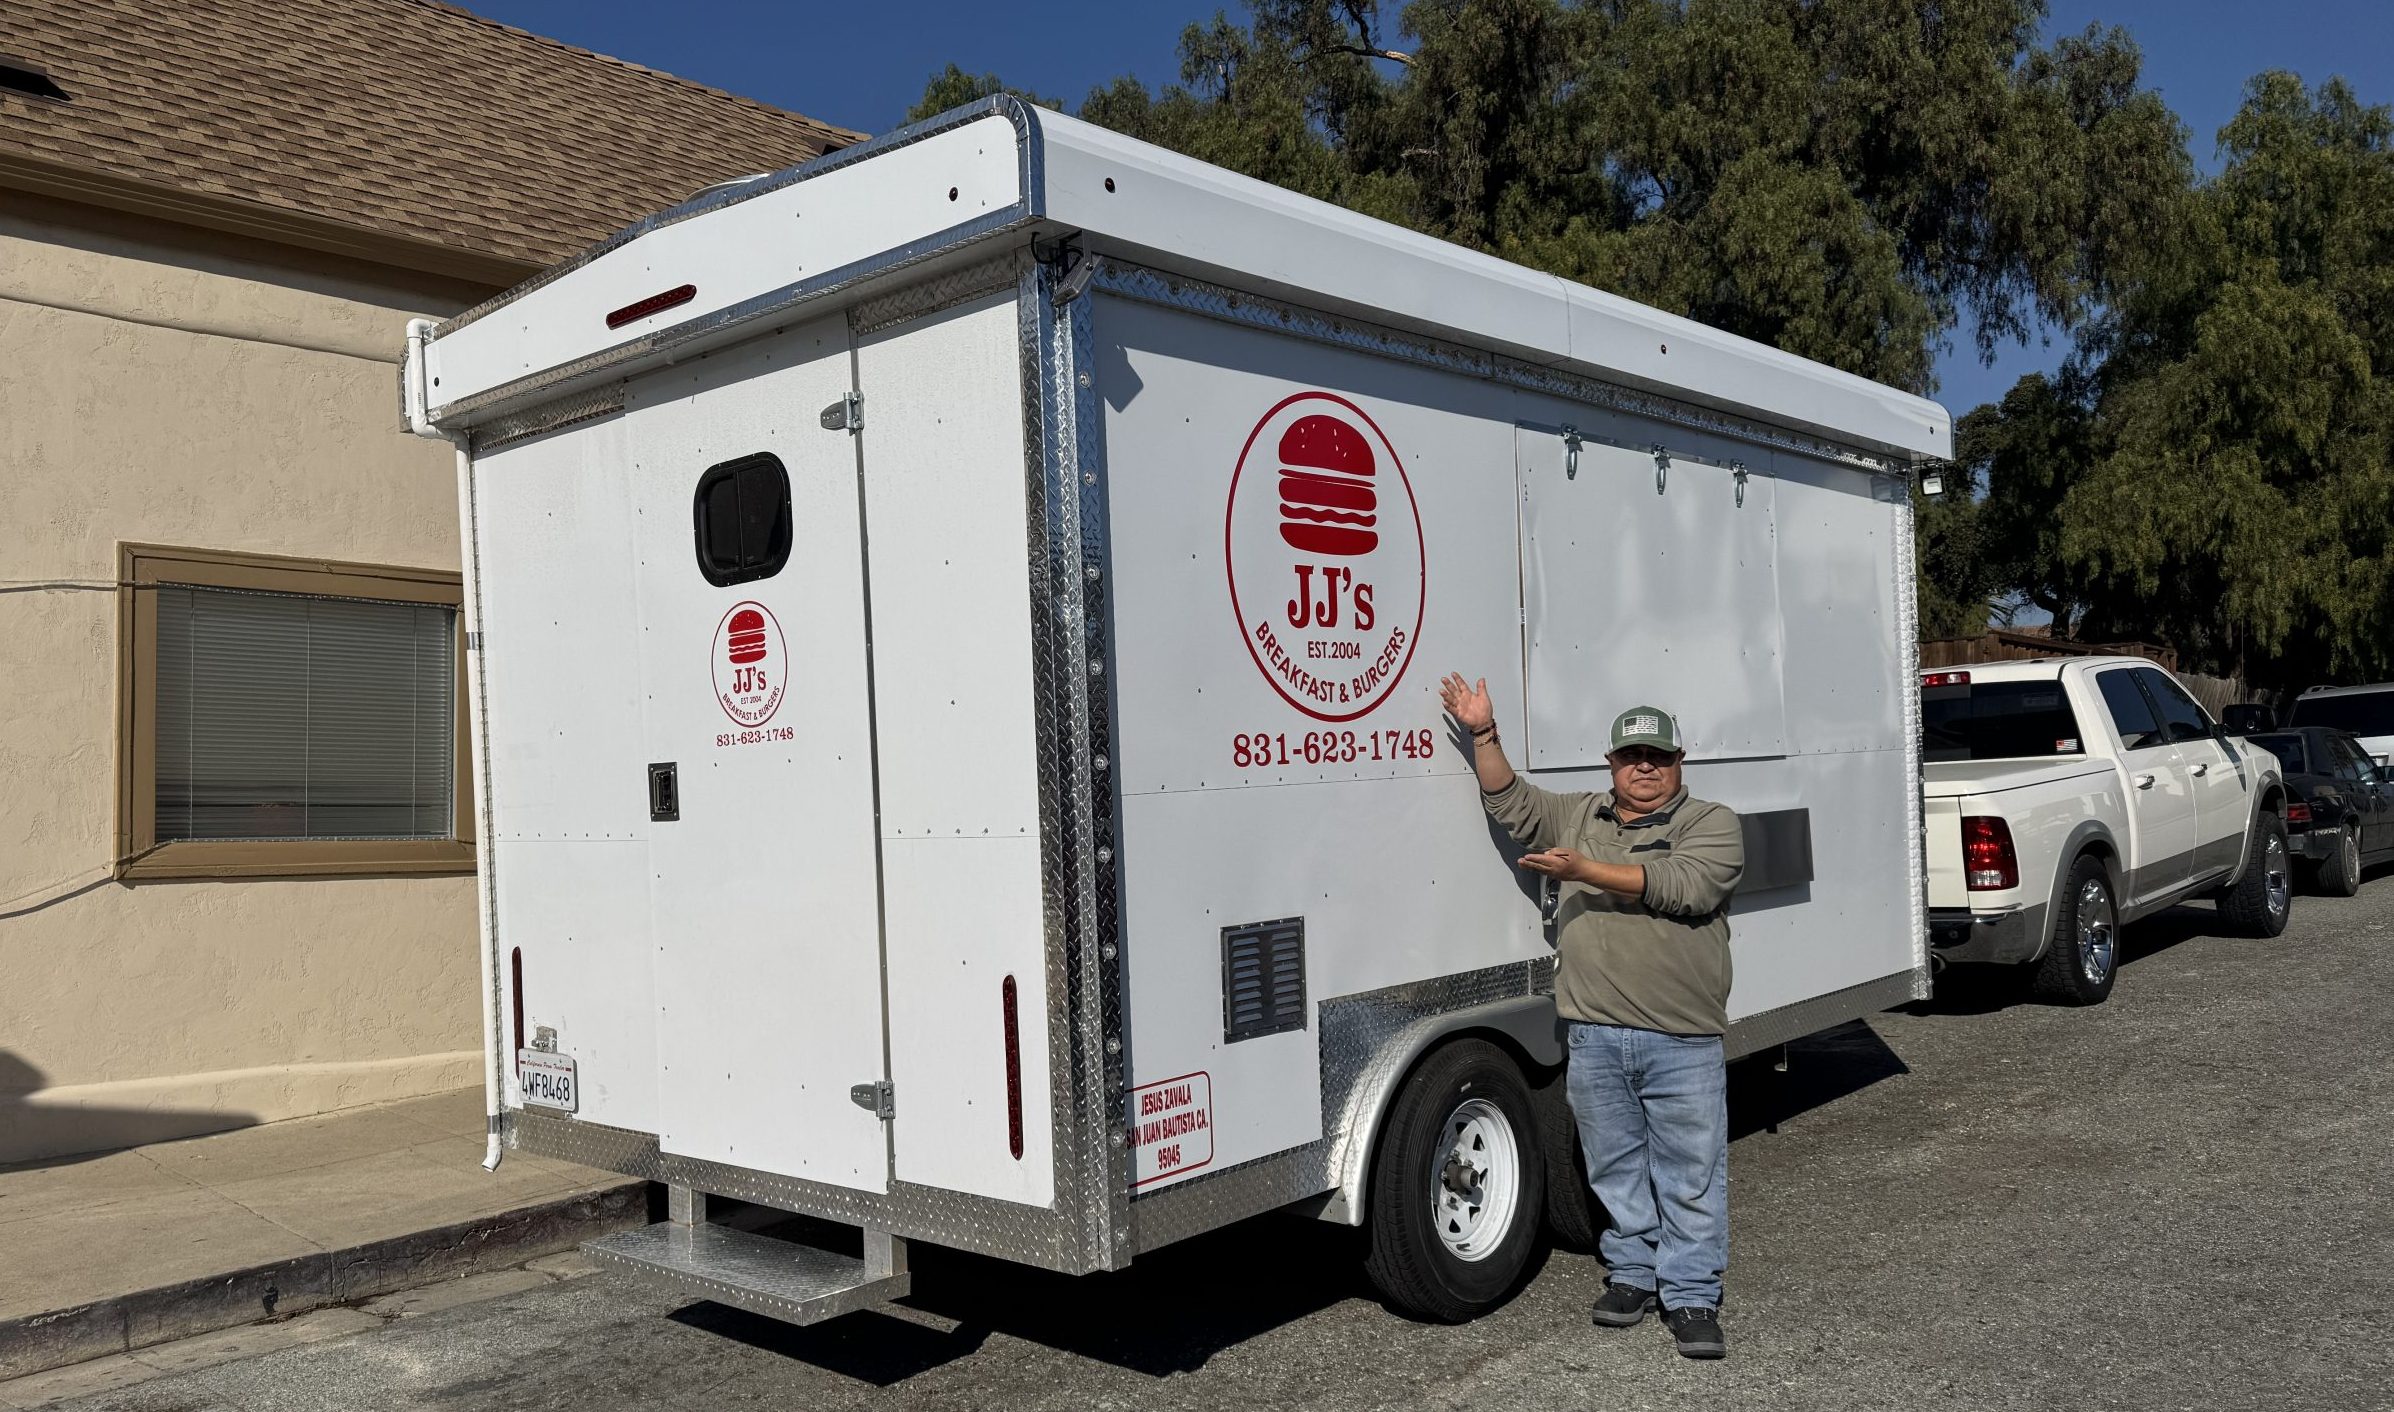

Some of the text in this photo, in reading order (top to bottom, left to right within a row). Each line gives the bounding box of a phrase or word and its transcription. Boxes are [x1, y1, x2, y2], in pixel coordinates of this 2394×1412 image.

[1287, 564, 1375, 631] JJ's
[1256, 621, 1406, 704] BREAKFAST & BURGERS
[1307, 640, 1361, 660] EST.2004
[732, 666, 766, 693] JJ's
[722, 686, 780, 721] BREAKFAST & BURGERS
[716, 727, 794, 746] 831-623-1748
[1233, 728, 1434, 768] 831-623-1748
[522, 1071, 570, 1101] 4WF8468
[1141, 1083, 1192, 1117] JESUS ZAVALA
[1126, 1108, 1209, 1150] SAN JUAN BAUTISTA CA.
[1158, 1144, 1181, 1170] 95045
